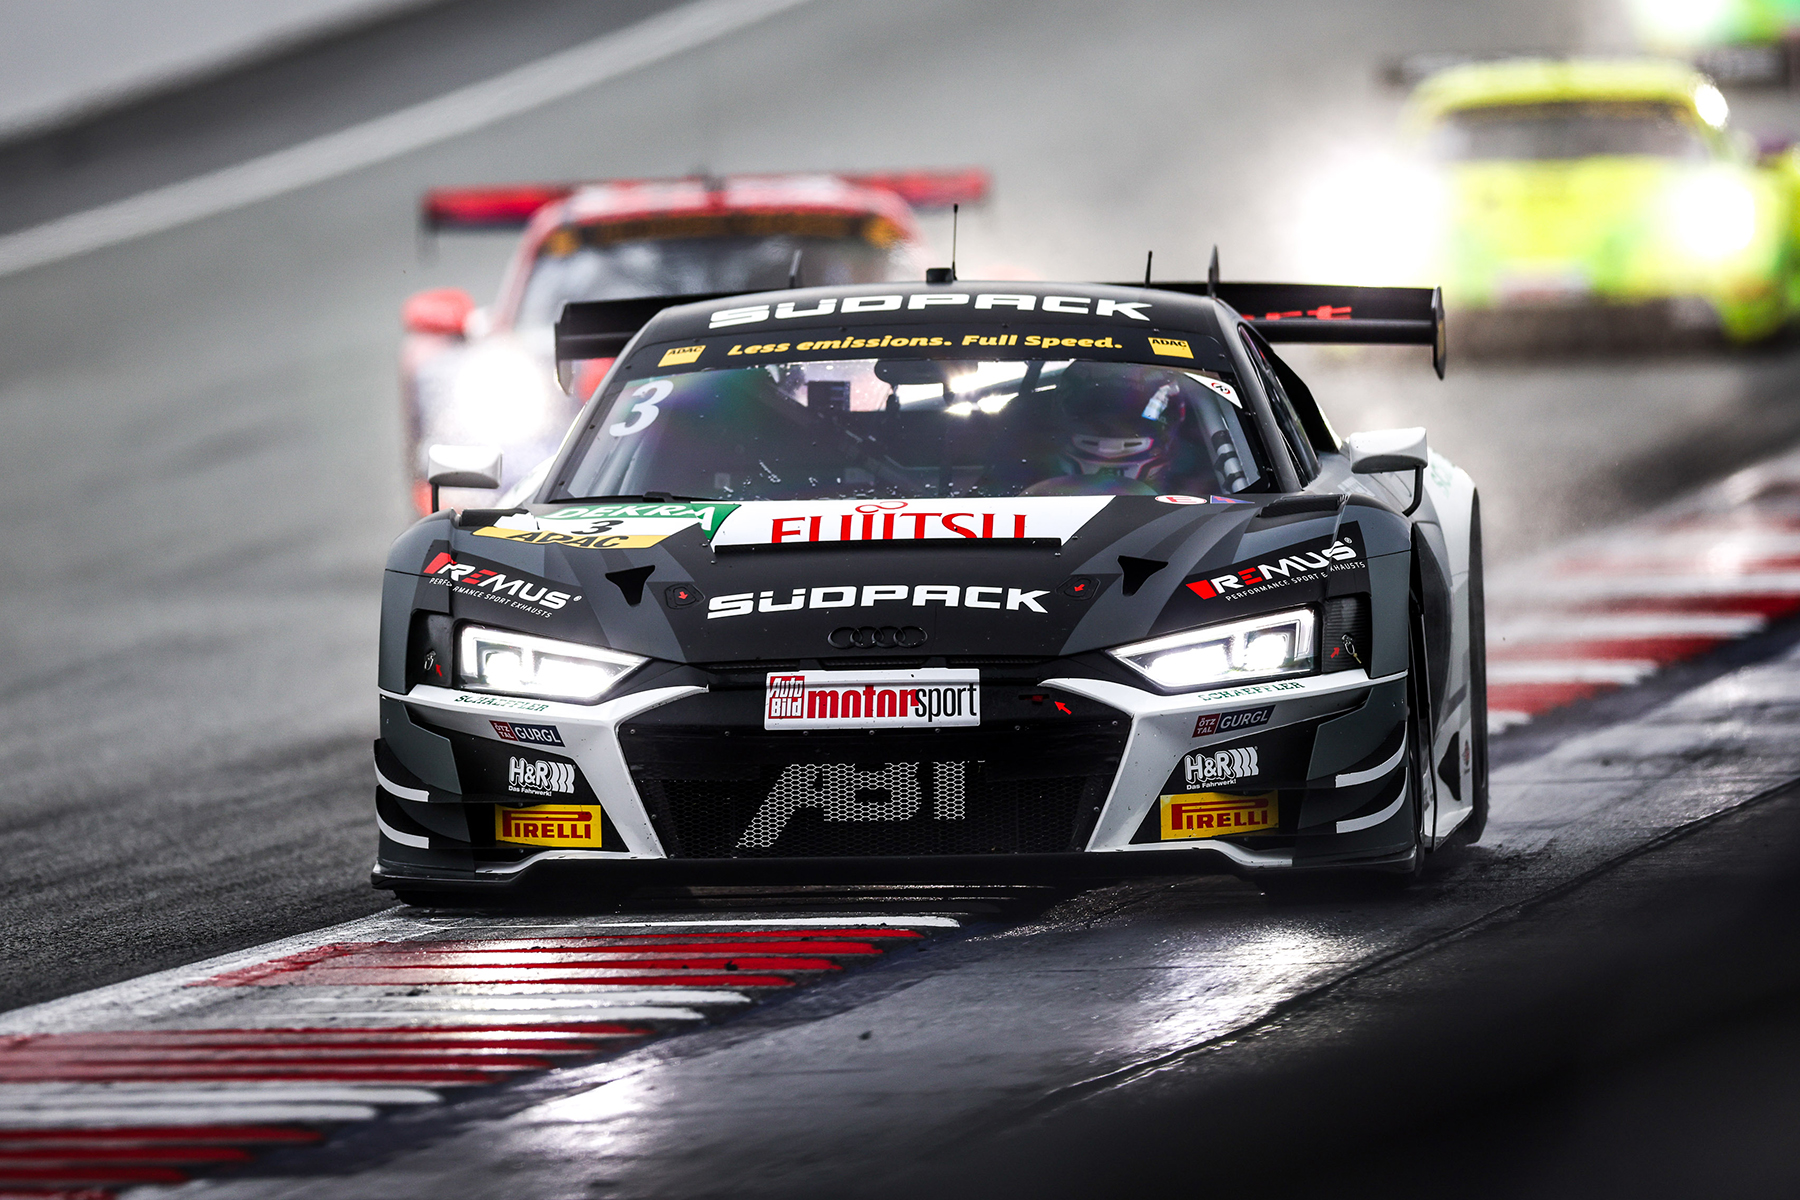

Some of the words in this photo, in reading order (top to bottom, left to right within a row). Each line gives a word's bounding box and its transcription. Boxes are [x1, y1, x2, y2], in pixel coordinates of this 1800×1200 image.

[727, 344, 791, 356] Less
[796, 335, 953, 351] emissions.
[961, 334, 1018, 346] Full
[1024, 335, 1123, 349] Speed.
[1152, 338, 1187, 348] ADAC
[609, 379, 674, 437] 3
[547, 504, 716, 532] DEKRA
[571, 520, 624, 535] 3
[506, 531, 630, 549] ADAC
[1225, 581, 1290, 602] PERFORMANCE
[1291, 572, 1319, 586] SPORT
[429, 577, 485, 598] PERFORMANCE
[484, 594, 510, 605] SPORT
[510, 601, 553, 619] EXHAUSTS
[769, 677, 803, 698] Auto
[1198, 681, 1305, 701] SCHAEFFLER
[454, 695, 549, 712] SCHAEFFLER
[770, 698, 802, 717] Bild
[495, 723, 510, 732] ÖTZ
[1199, 717, 1216, 727] ÖTZ
[1220, 710, 1268, 729] GURGL
[514, 727, 561, 743] GURGL
[1197, 727, 1213, 735] TAL
[509, 756, 552, 791] H&R
[1184, 750, 1236, 784] H&R
[521, 787, 552, 797] Fahrwerk!
[1186, 782, 1200, 790] Das
[1202, 778, 1237, 789] Fahrwerk!
[502, 811, 593, 839] PIRELLI
[1171, 800, 1269, 831] PIRELLI
